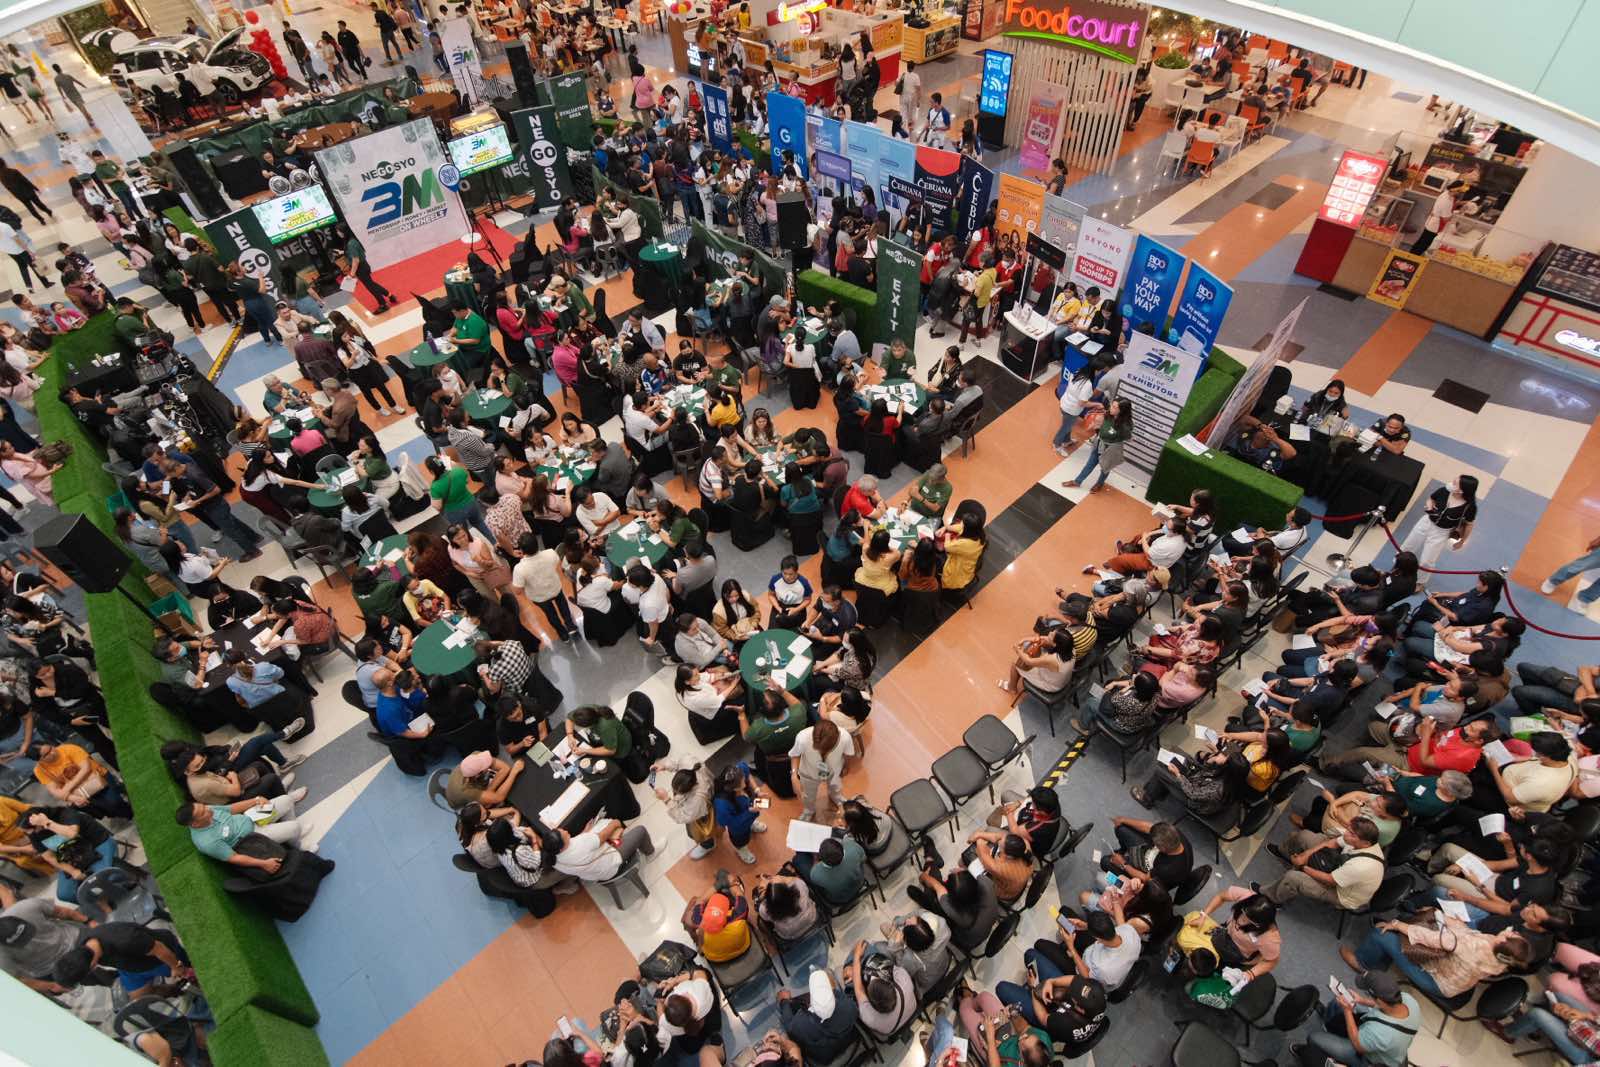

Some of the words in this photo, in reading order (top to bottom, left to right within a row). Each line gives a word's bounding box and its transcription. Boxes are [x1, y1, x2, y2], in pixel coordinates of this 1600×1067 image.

[1005, 0, 1139, 48] Foodcourt
[361, 157, 415, 182] NEGOSYO
[360, 167, 445, 230] 3M
[1081, 258, 1095, 270] NOW
[1135, 283, 1160, 307] YOUR
[1141, 276, 1160, 293] PAY
[890, 278, 902, 332] EXIT
[1134, 294, 1156, 313] WAY
[1139, 352, 1180, 378] 3M
[1127, 373, 1180, 399] EXHIBITORS
